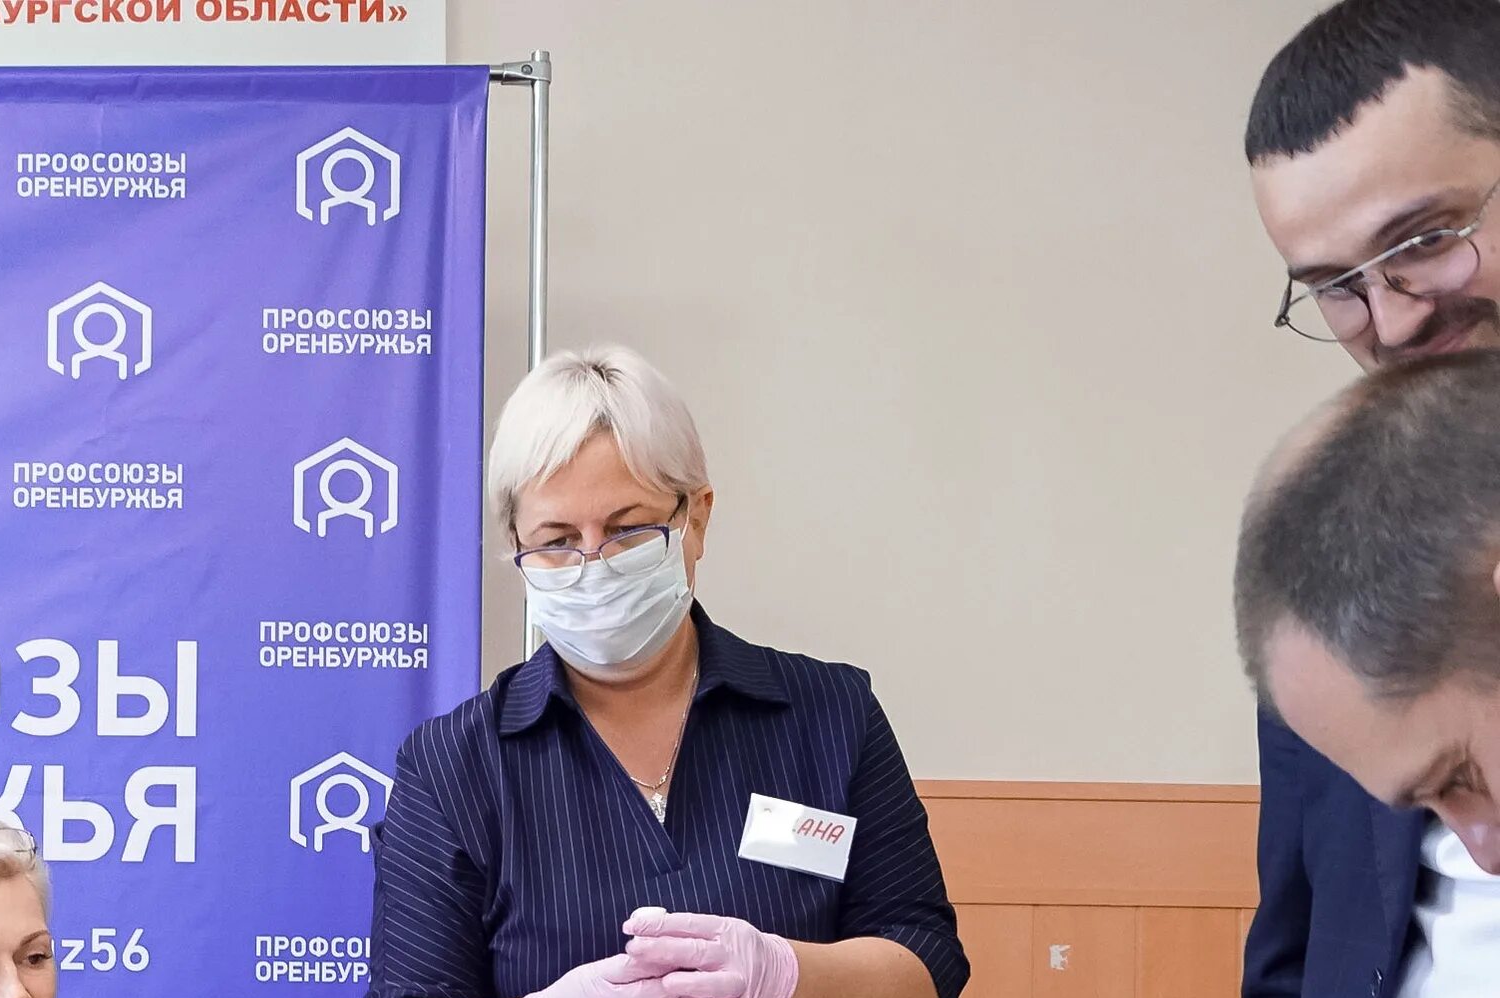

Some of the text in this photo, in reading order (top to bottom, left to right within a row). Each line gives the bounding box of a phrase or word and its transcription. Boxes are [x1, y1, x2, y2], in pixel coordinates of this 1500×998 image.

[196, 0, 407, 23] ОБЛАСТИ»
[18, 153, 186, 174] ПРОФСОЮЗЫ
[18, 177, 186, 199] ОРЕНБУРЖЬЯ
[263, 309, 432, 330] ПРОФСОЮЗЫ
[262, 333, 432, 355] ОРЕНБУРЖЬЯ
[13, 463, 183, 485] ПРОФСОЮЗЫ
[13, 487, 183, 509] ОРЕНБУРЖЬЯ
[260, 621, 428, 644] ПРОФСОЮЗЫ
[259, 646, 428, 669] ОРЕНБУРЖЬЯ
